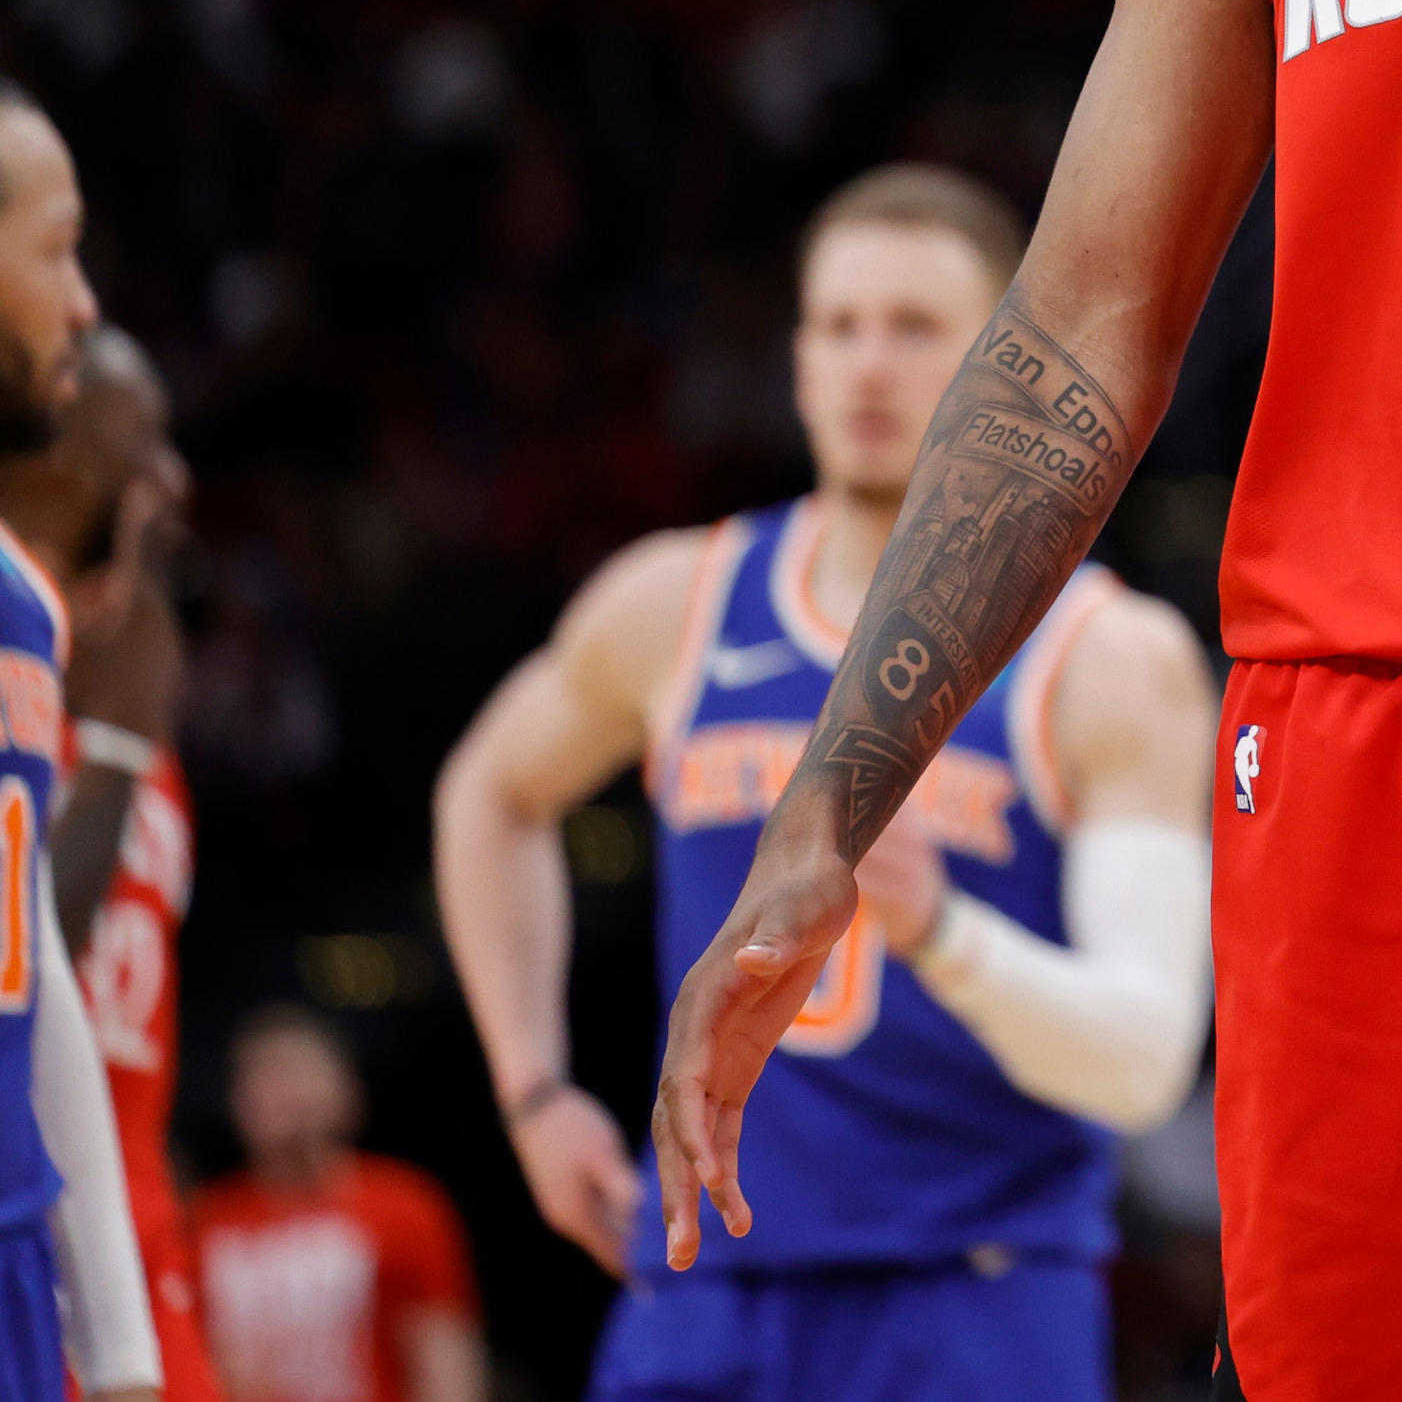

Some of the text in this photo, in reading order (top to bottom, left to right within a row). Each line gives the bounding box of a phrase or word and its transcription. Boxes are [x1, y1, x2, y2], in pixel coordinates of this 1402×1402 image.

[982, 326, 1123, 468] Van Epps
[966, 413, 1107, 499] Flatshoals
